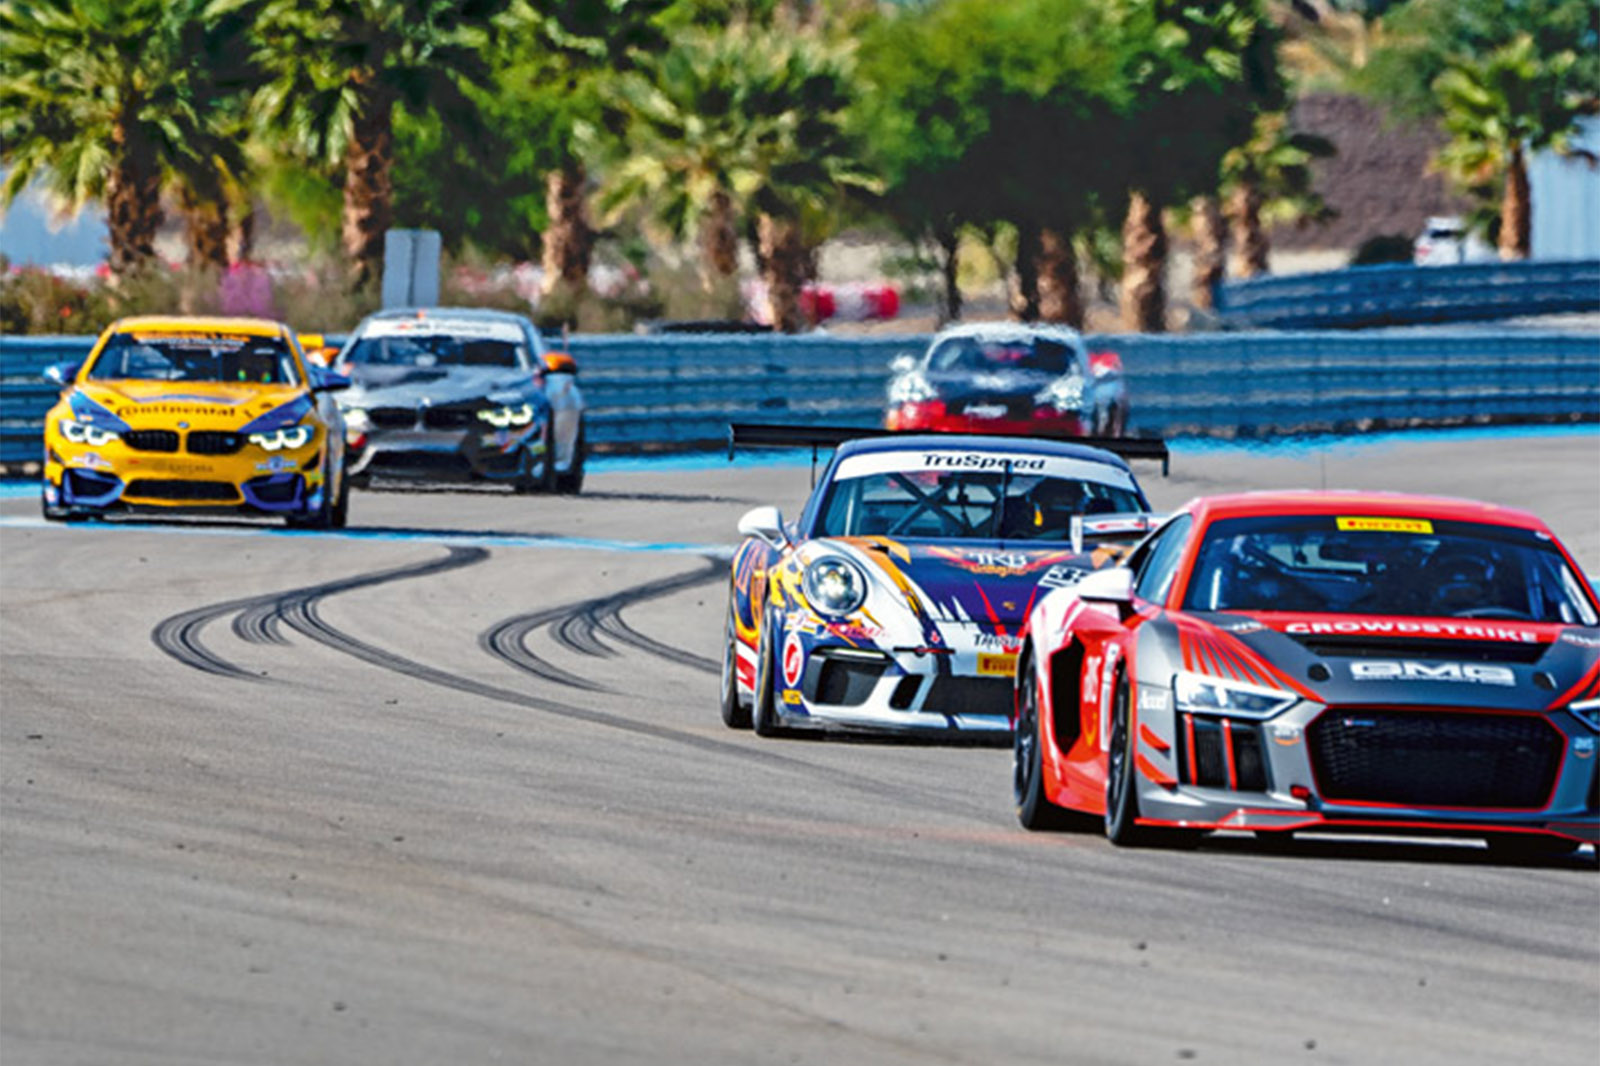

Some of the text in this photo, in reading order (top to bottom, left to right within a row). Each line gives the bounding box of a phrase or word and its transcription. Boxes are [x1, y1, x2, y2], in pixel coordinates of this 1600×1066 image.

[117, 403, 236, 418] Continental
[923, 453, 1046, 470] TruSpeed
[1286, 621, 1538, 644] CROWDSTRIKE
[1351, 660, 1516, 686] GMG
